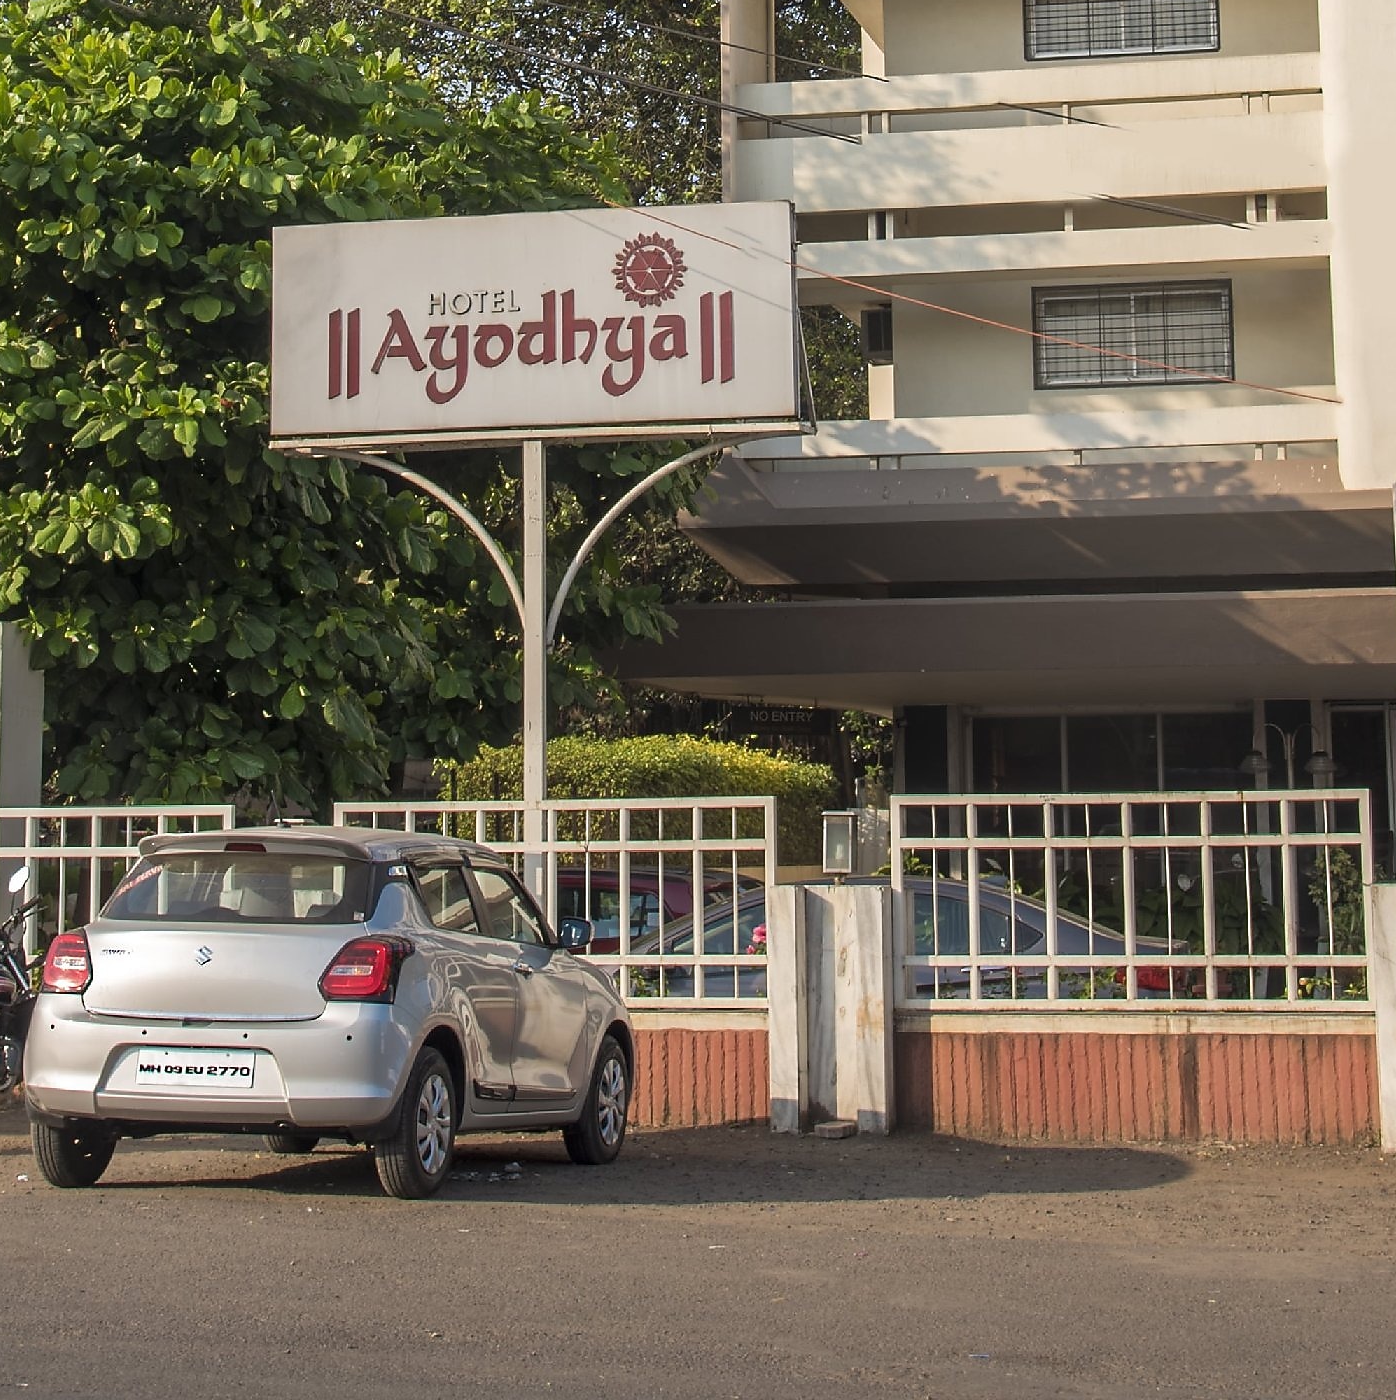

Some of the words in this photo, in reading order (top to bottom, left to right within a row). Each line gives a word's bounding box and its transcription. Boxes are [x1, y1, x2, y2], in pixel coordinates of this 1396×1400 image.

[428, 289, 521, 316] HOTEL
[750, 711, 769, 722] NO
[771, 711, 813, 722] ENTRY
[139, 1064, 161, 1074] MH
[164, 1065, 183, 1075] 09
[185, 1066, 204, 1075] EU
[206, 1066, 251, 1077] 2770
